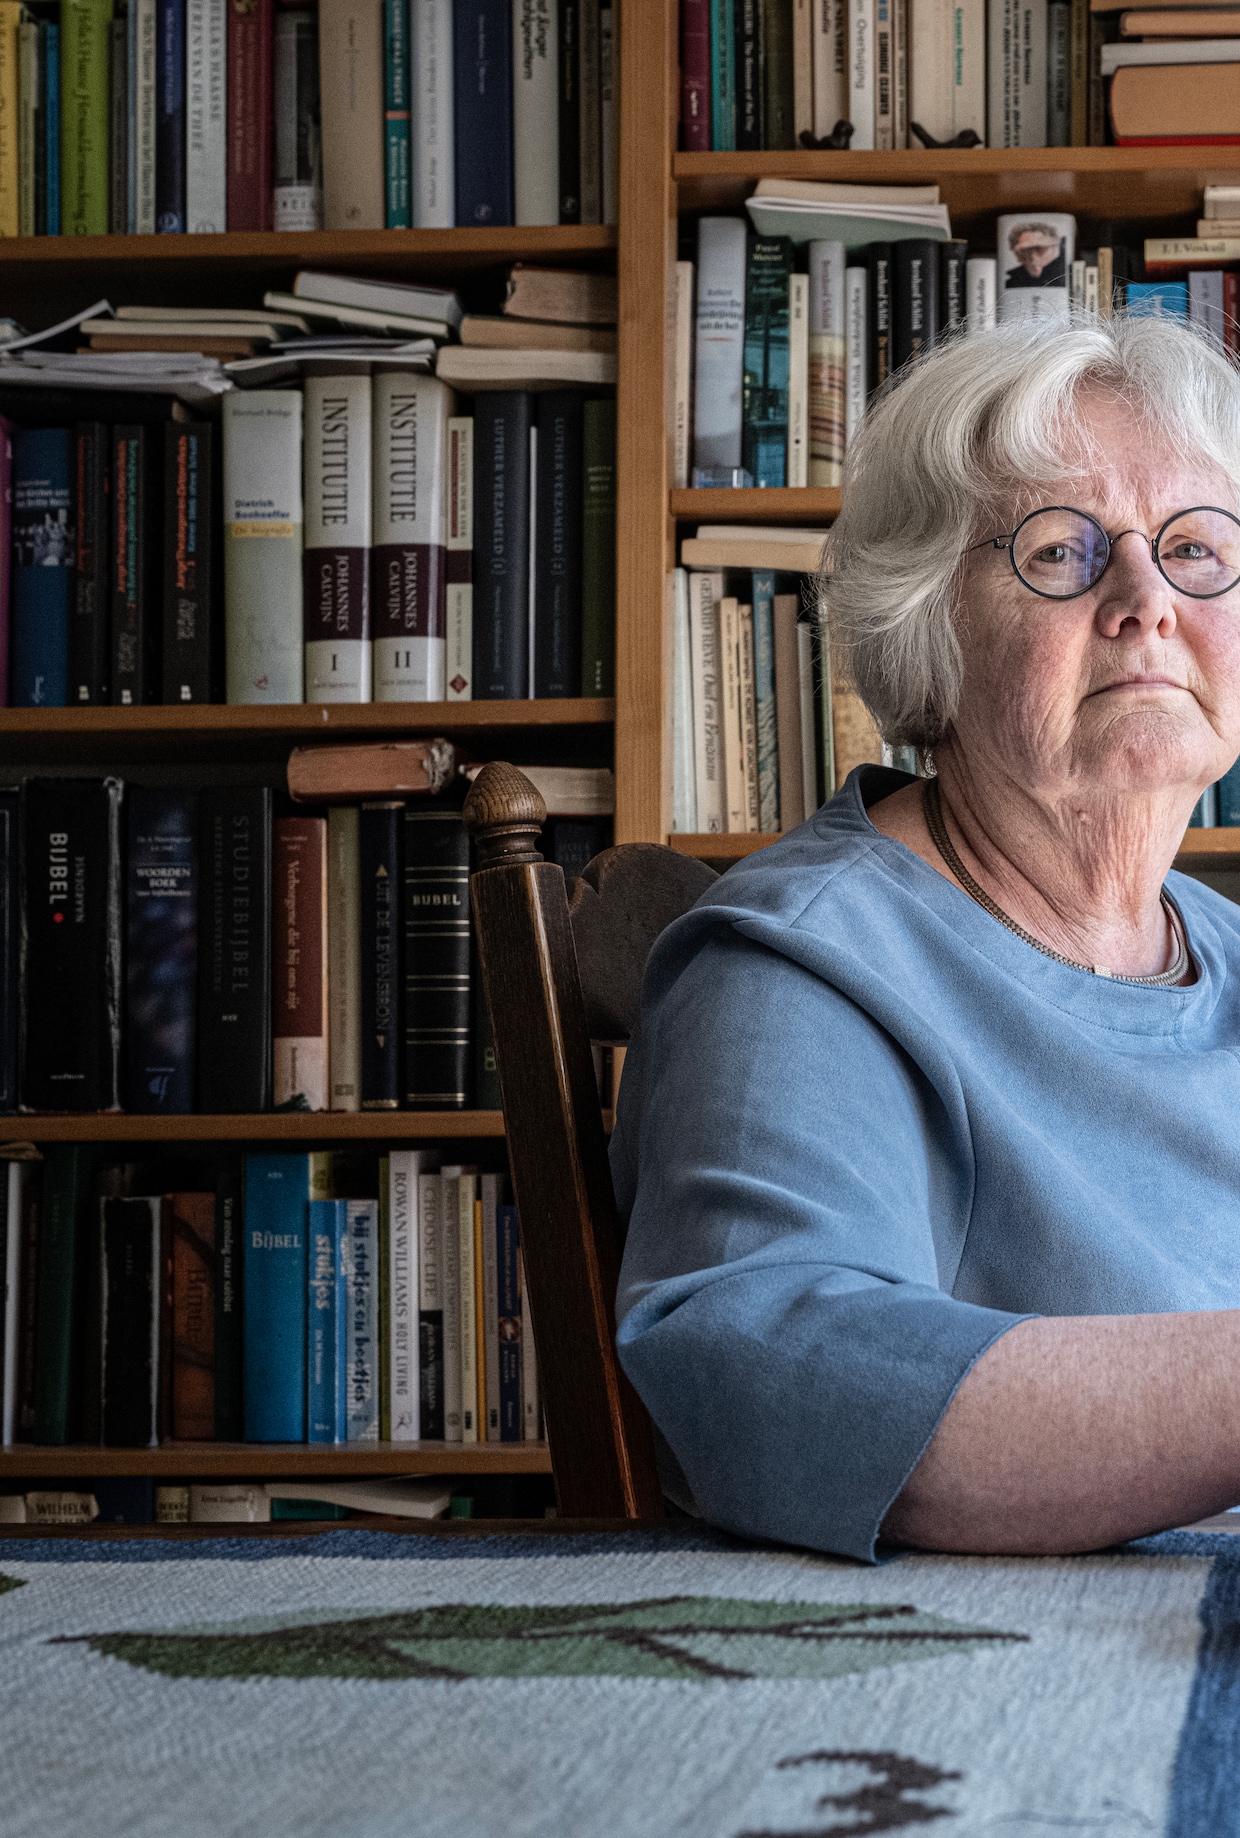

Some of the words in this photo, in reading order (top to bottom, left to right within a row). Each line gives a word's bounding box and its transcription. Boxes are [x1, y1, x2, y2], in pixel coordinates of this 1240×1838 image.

[191, 48, 203, 78] VAN
[855, 18, 867, 89] Overtuiging
[191, 83, 203, 105] DE
[192, 109, 204, 151] THEE
[877, 260, 888, 299] Bernhard
[911, 259, 922, 298] Bernhard
[949, 259, 958, 298] Bernhard
[390, 393, 417, 523] INSTITUTIE
[494, 417, 504, 471] LUTHER
[553, 417, 564, 471] LUTHER
[321, 397, 348, 527] INSTITUTIE
[335, 555, 349, 632] JOHANNES
[494, 475, 504, 554] VERZAMELD
[553, 474, 564, 554] VERZAMELD
[320, 564, 335, 623] CALVIJN
[388, 561, 402, 620] CALVIJN
[402, 551, 417, 629] JOHANNES
[700, 577, 715, 631] GERARD
[702, 633, 716, 668] REVE
[703, 672, 719, 703] Oud
[705, 705, 716, 721] en
[704, 722, 720, 781] Eenzaam
[50, 833, 68, 904] BIJBEL
[231, 815, 250, 993] STUDIEBIJBEL
[377, 910, 389, 928] DE
[285, 948, 300, 965] bij
[287, 928, 301, 946] die
[288, 967, 298, 988] ons
[353, 1215, 370, 1238] bij
[394, 1171, 408, 1234] ROWAN
[423, 1187, 437, 1256] CHOOSE
[309, 1234, 333, 1310] stukjes
[351, 1242, 370, 1307] stukjes
[394, 1236, 408, 1316] WILLIAMS
[424, 1262, 437, 1297] LIFE
[396, 1322, 408, 1351] HOLY
[353, 1337, 370, 1403] beetjes
[396, 1355, 408, 1396] LIVING
